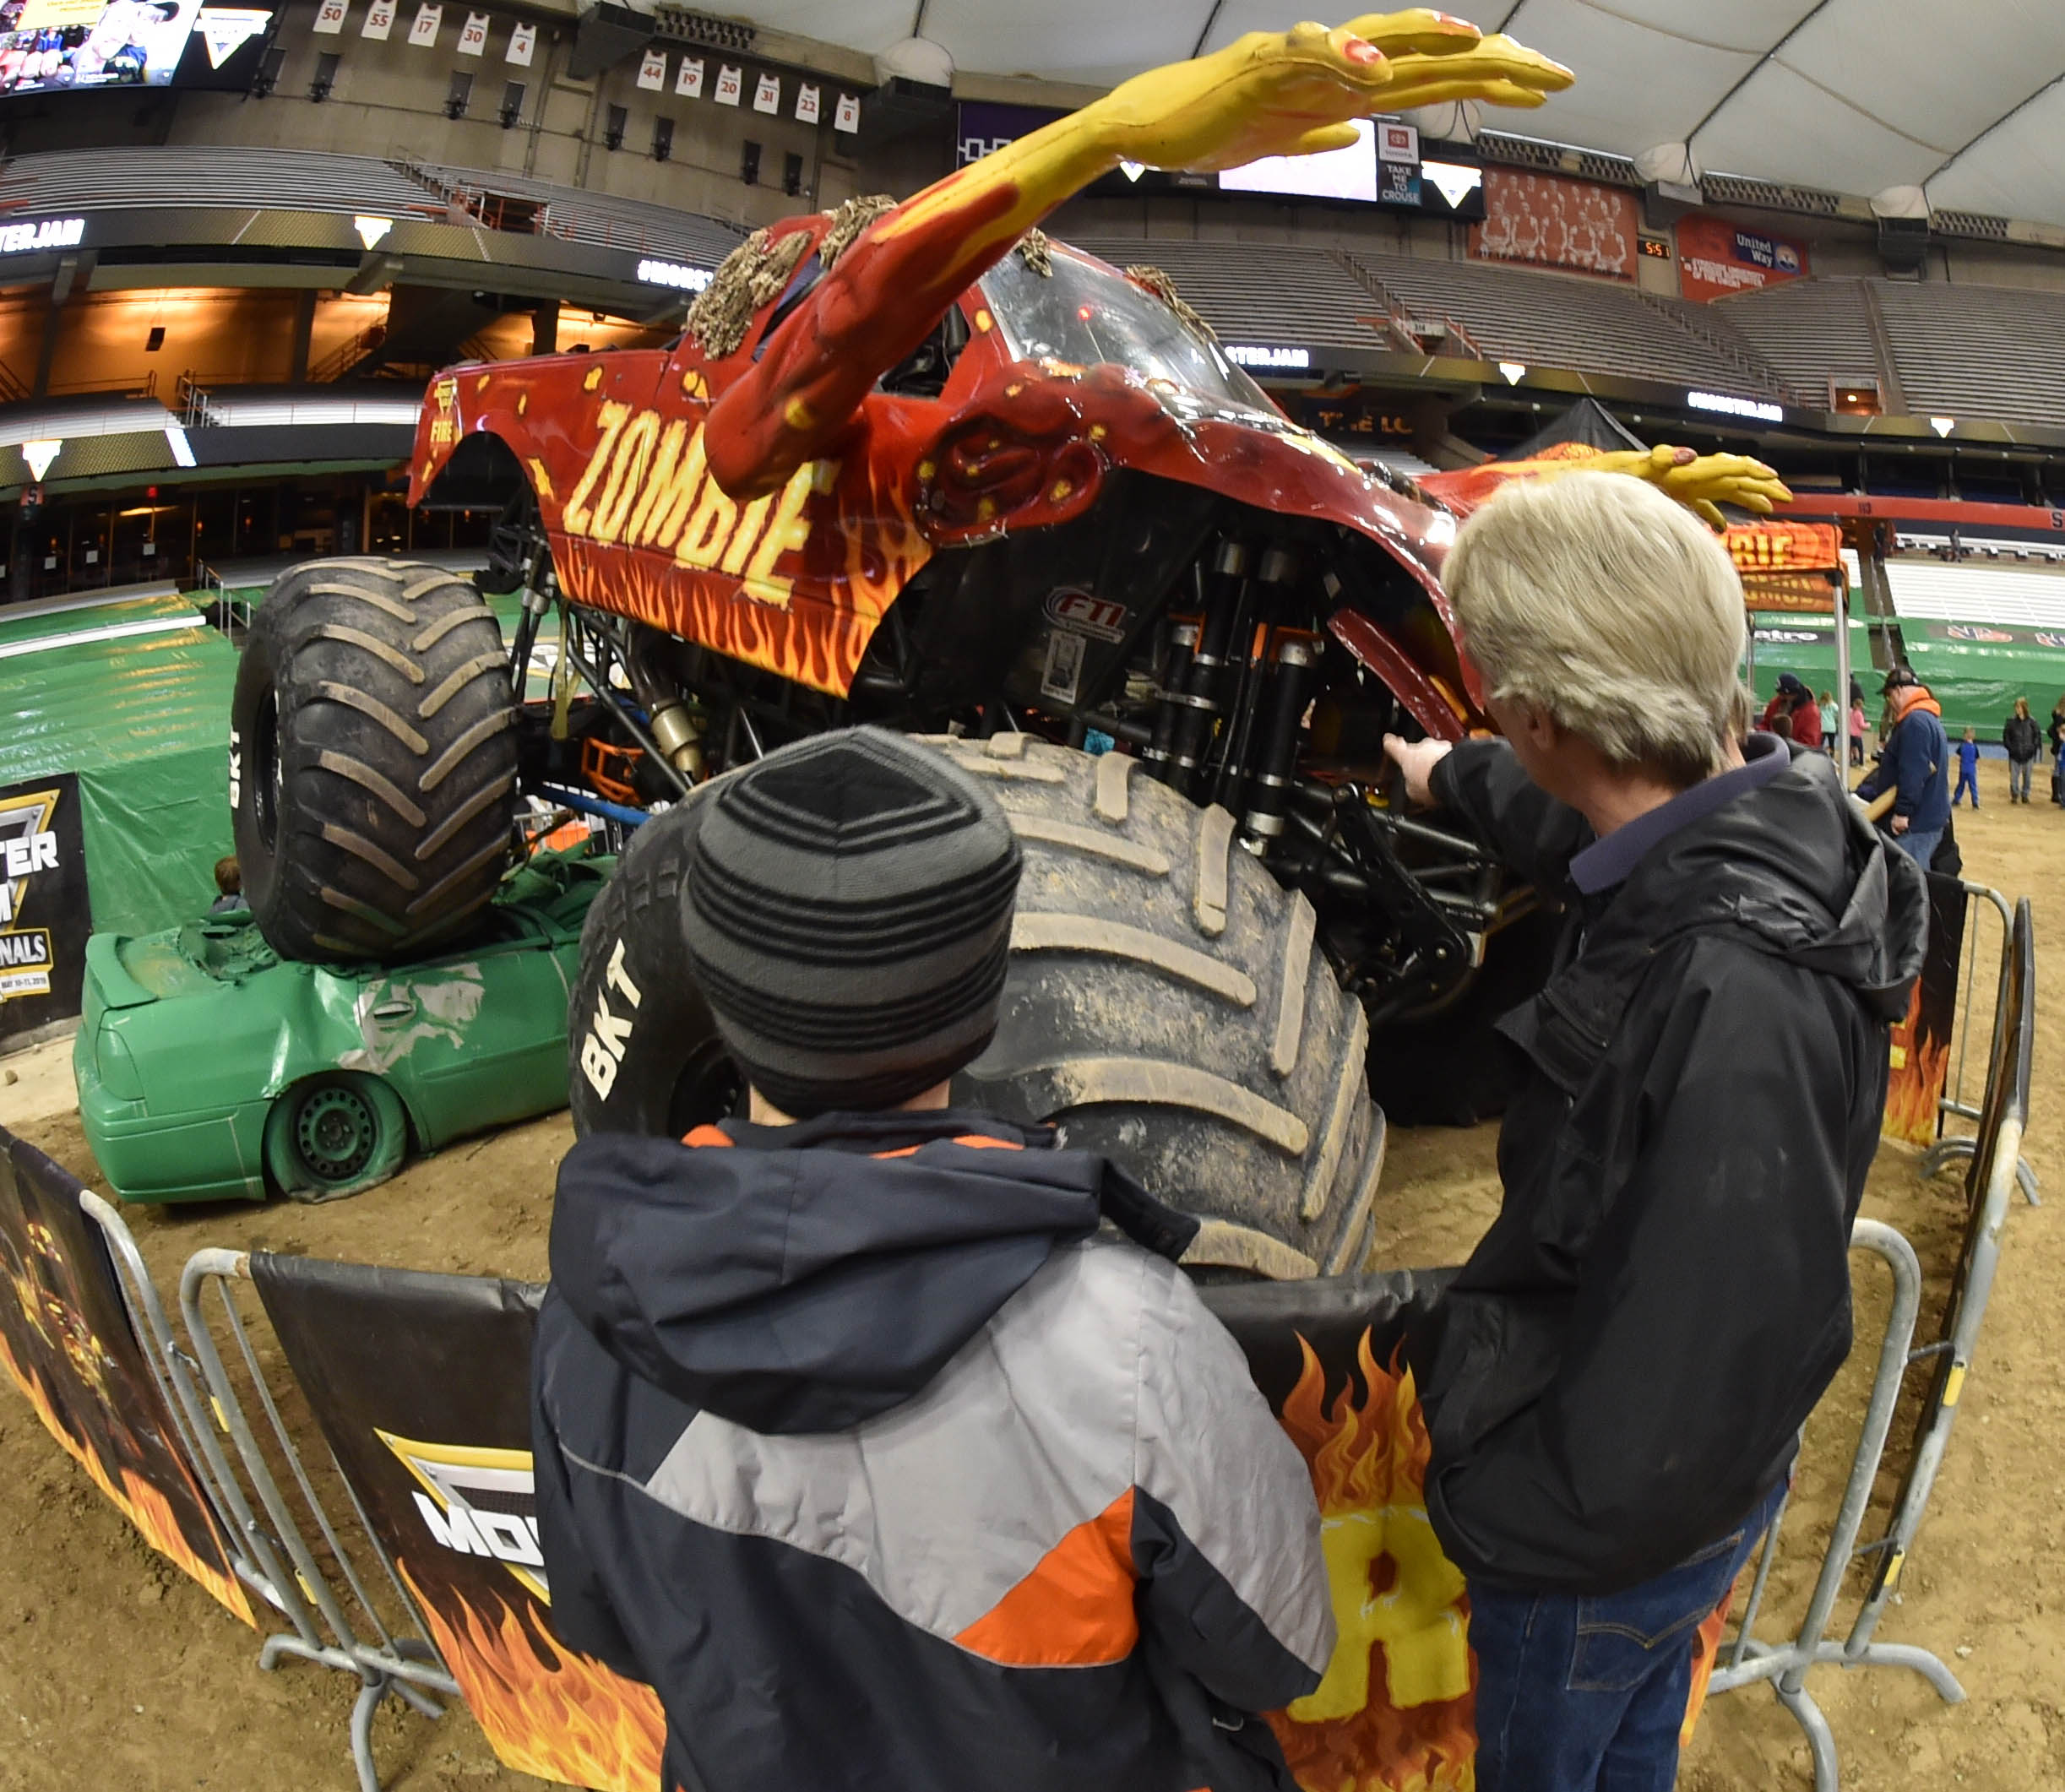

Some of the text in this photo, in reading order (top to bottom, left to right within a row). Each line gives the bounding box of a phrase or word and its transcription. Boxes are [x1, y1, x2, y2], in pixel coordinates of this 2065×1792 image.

[322, 8, 342, 21] 50
[369, 14, 389, 27] 55
[416, 20, 432, 34] 17
[464, 30, 482, 43] 30
[516, 41, 526, 53] 4
[644, 67, 661, 79] 44
[682, 73, 697, 85] 19
[720, 81, 737, 94] 20
[761, 91, 774, 103] 31
[801, 99, 816, 113] 22
[1386, 165, 1412, 176] TAKE
[1394, 183, 1407, 192] TO
[1382, 188, 1419, 204] CROUSE
[1736, 233, 1772, 253] United
[1752, 248, 1773, 268] Way
[429, 420, 454, 443] FIRE
[1057, 593, 1125, 627] FTI
[229, 726, 242, 808] BKT
[0, 830, 60, 877] ER
[581, 937, 642, 1102] BKT
